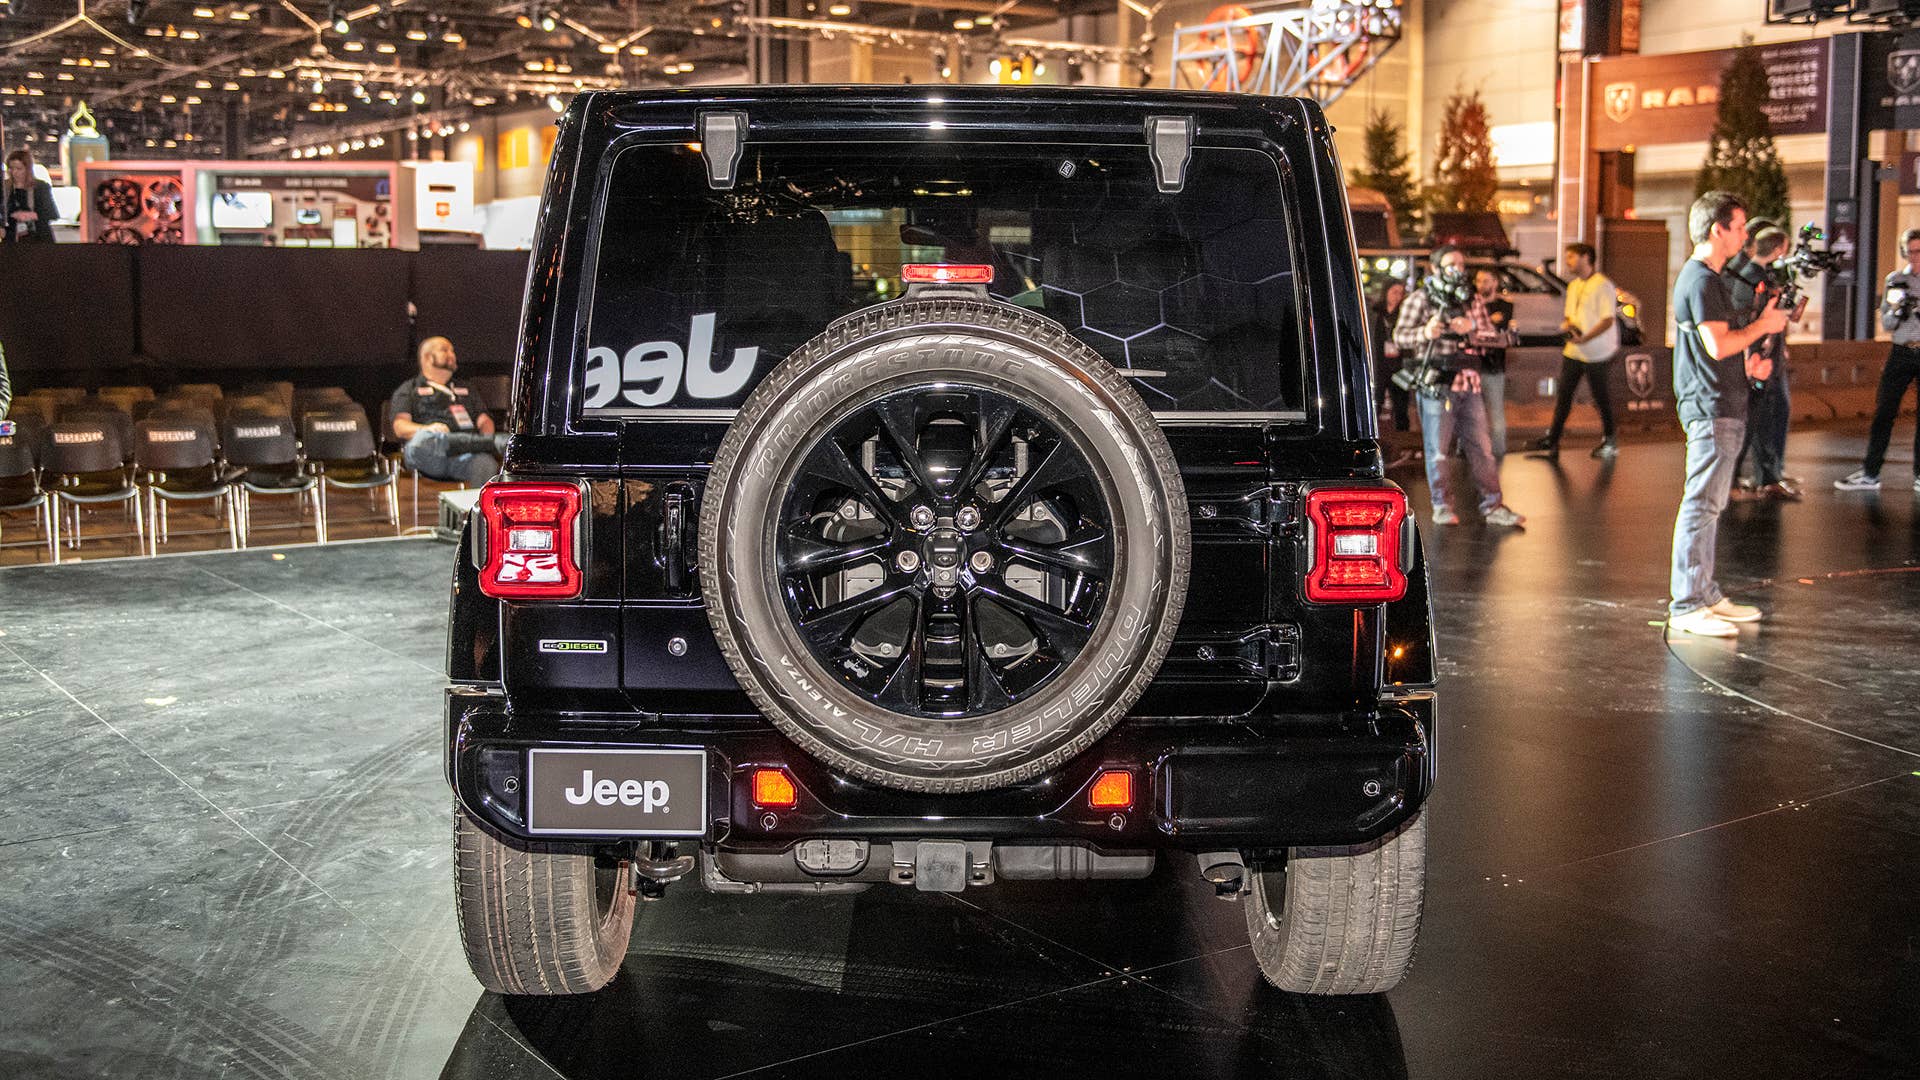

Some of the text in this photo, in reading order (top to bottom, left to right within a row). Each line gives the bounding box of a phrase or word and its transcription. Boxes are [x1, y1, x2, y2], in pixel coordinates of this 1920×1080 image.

[756, 348, 1025, 478] BRIDGESTONE
[780, 653, 848, 718] ALENZA
[972, 604, 1142, 755] DUELER
[852, 718, 943, 757] H/L
[565, 769, 670, 813] Jeep
